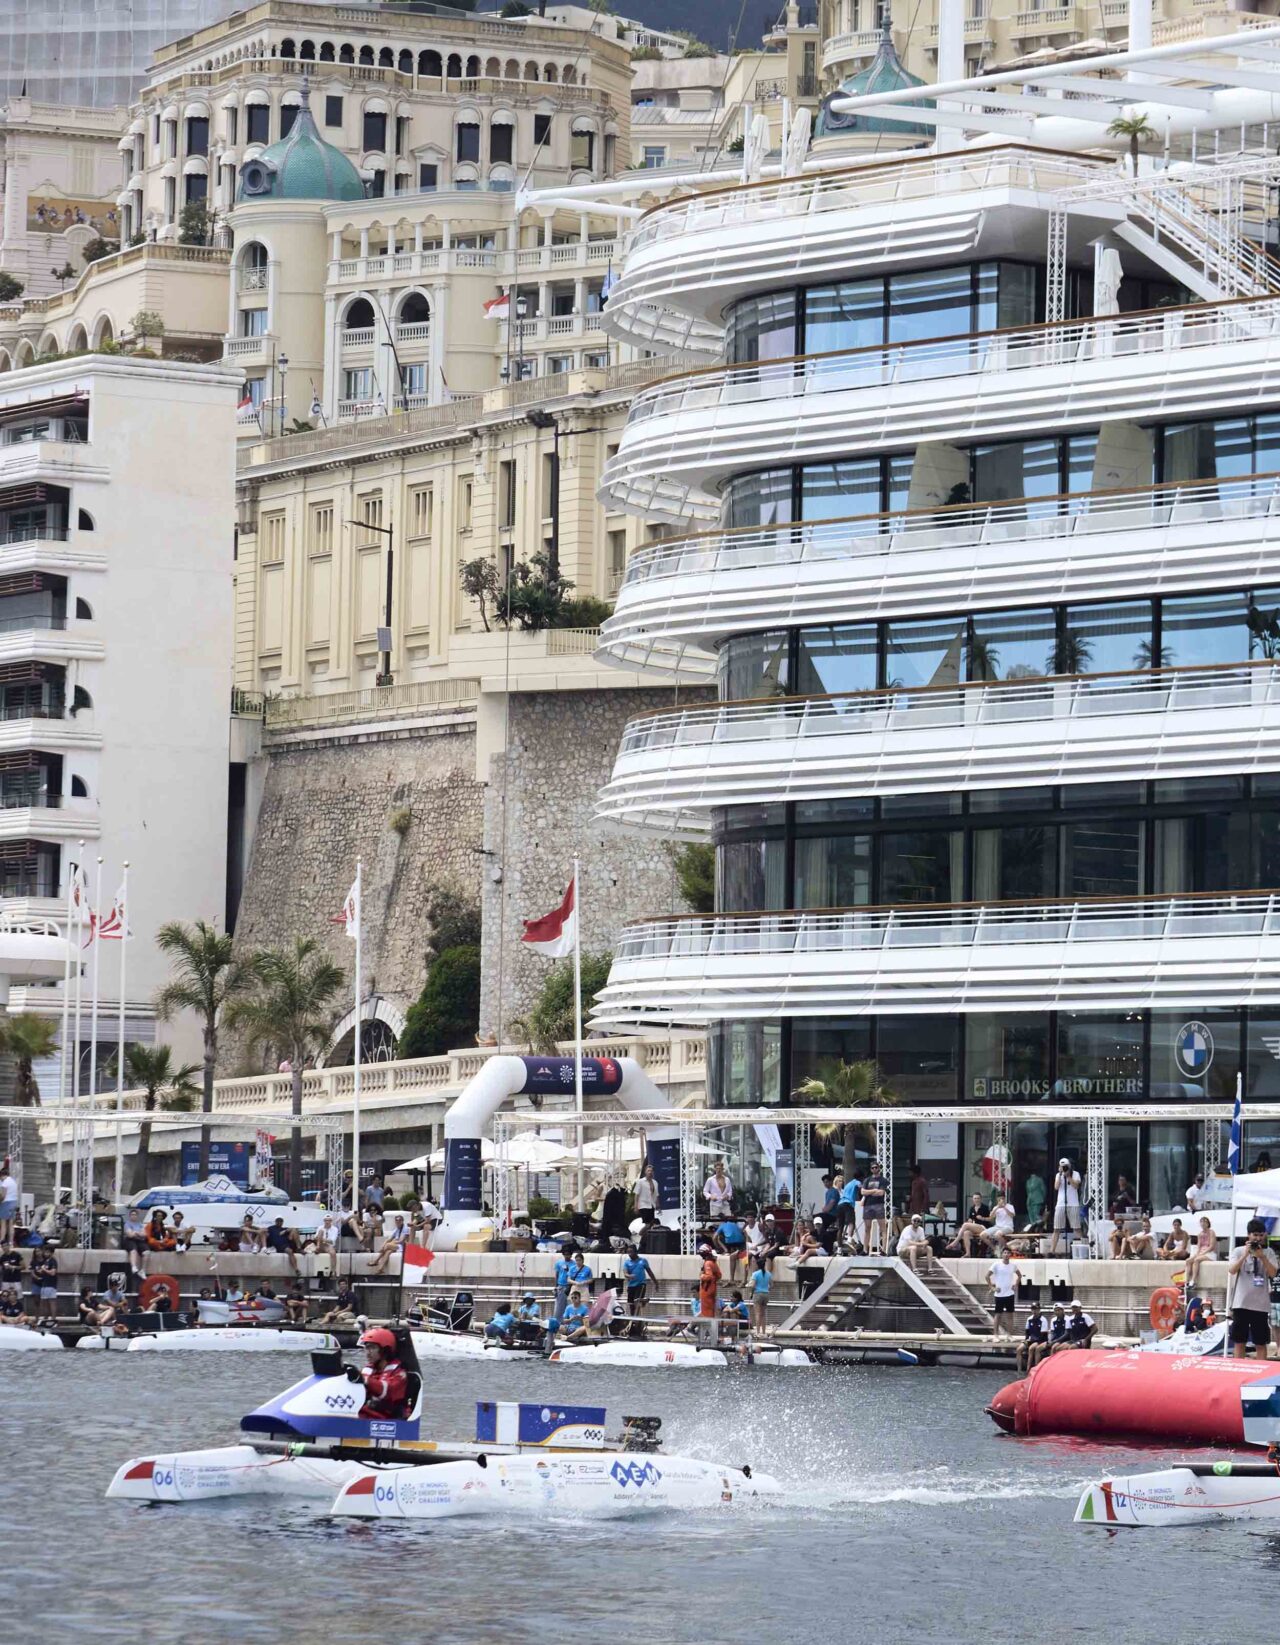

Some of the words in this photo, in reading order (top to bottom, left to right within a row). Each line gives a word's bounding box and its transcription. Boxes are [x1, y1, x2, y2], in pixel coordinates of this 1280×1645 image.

[1180, 1022, 1210, 1041] BMW
[991, 1079, 1050, 1095] BROOKS
[1063, 1077, 1143, 1094] BROTHERS
[154, 1470, 173, 1486] 06
[376, 1486, 394, 1501] 06
[1114, 1492, 1127, 1508] 12
